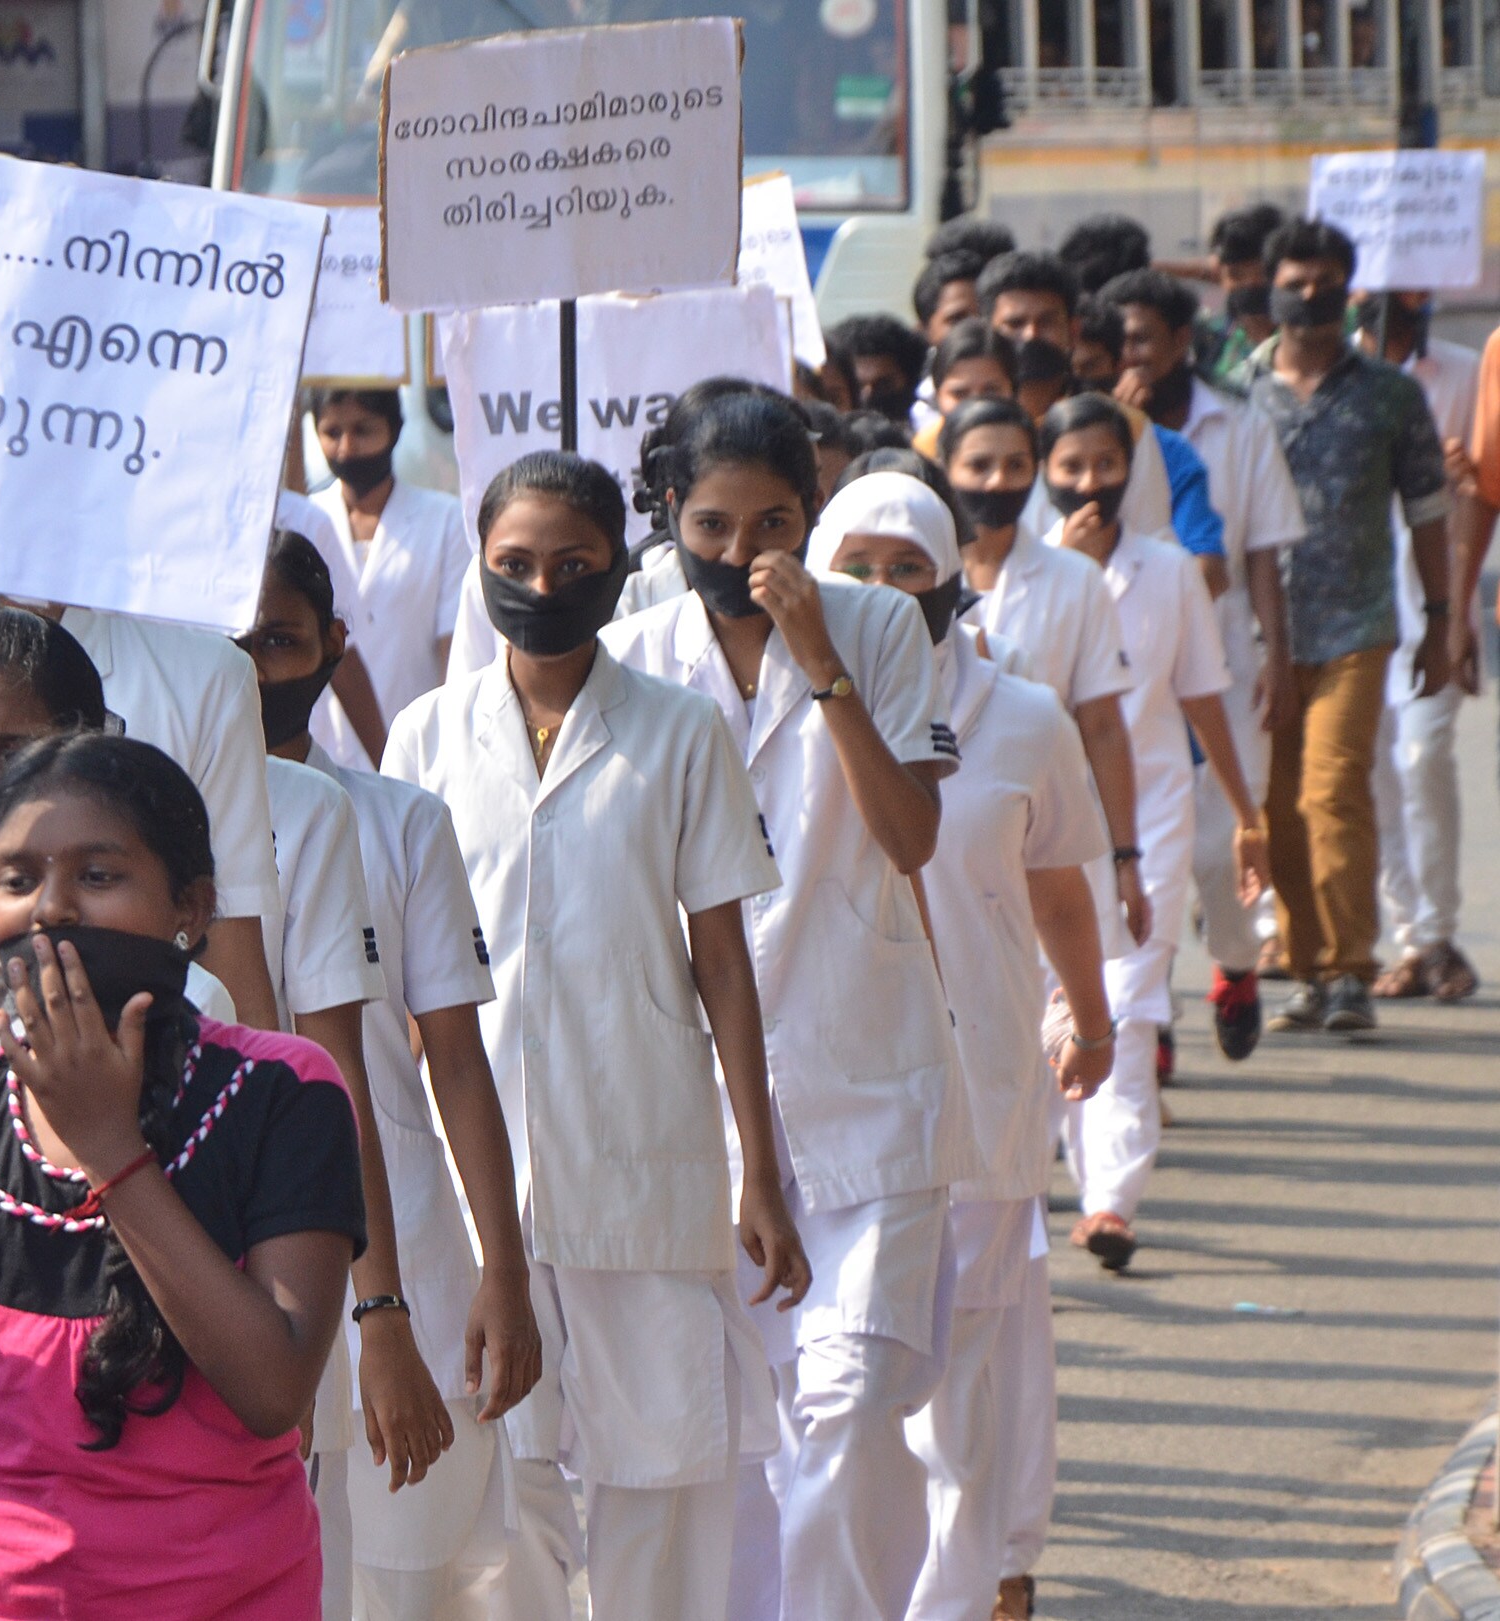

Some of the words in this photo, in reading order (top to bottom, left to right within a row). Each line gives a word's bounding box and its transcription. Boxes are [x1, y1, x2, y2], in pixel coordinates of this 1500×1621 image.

[394, 85, 724, 141] ഗോവിന്ദചാമിമാരുടെ
[445, 136, 671, 181] സംരക്ഷകരെ
[443, 184, 675, 230] തിരിച്ചറിയുക.
[12, 314, 229, 376] എന്നെ
[479, 391, 562, 435] We
[588, 391, 678, 429] wa
